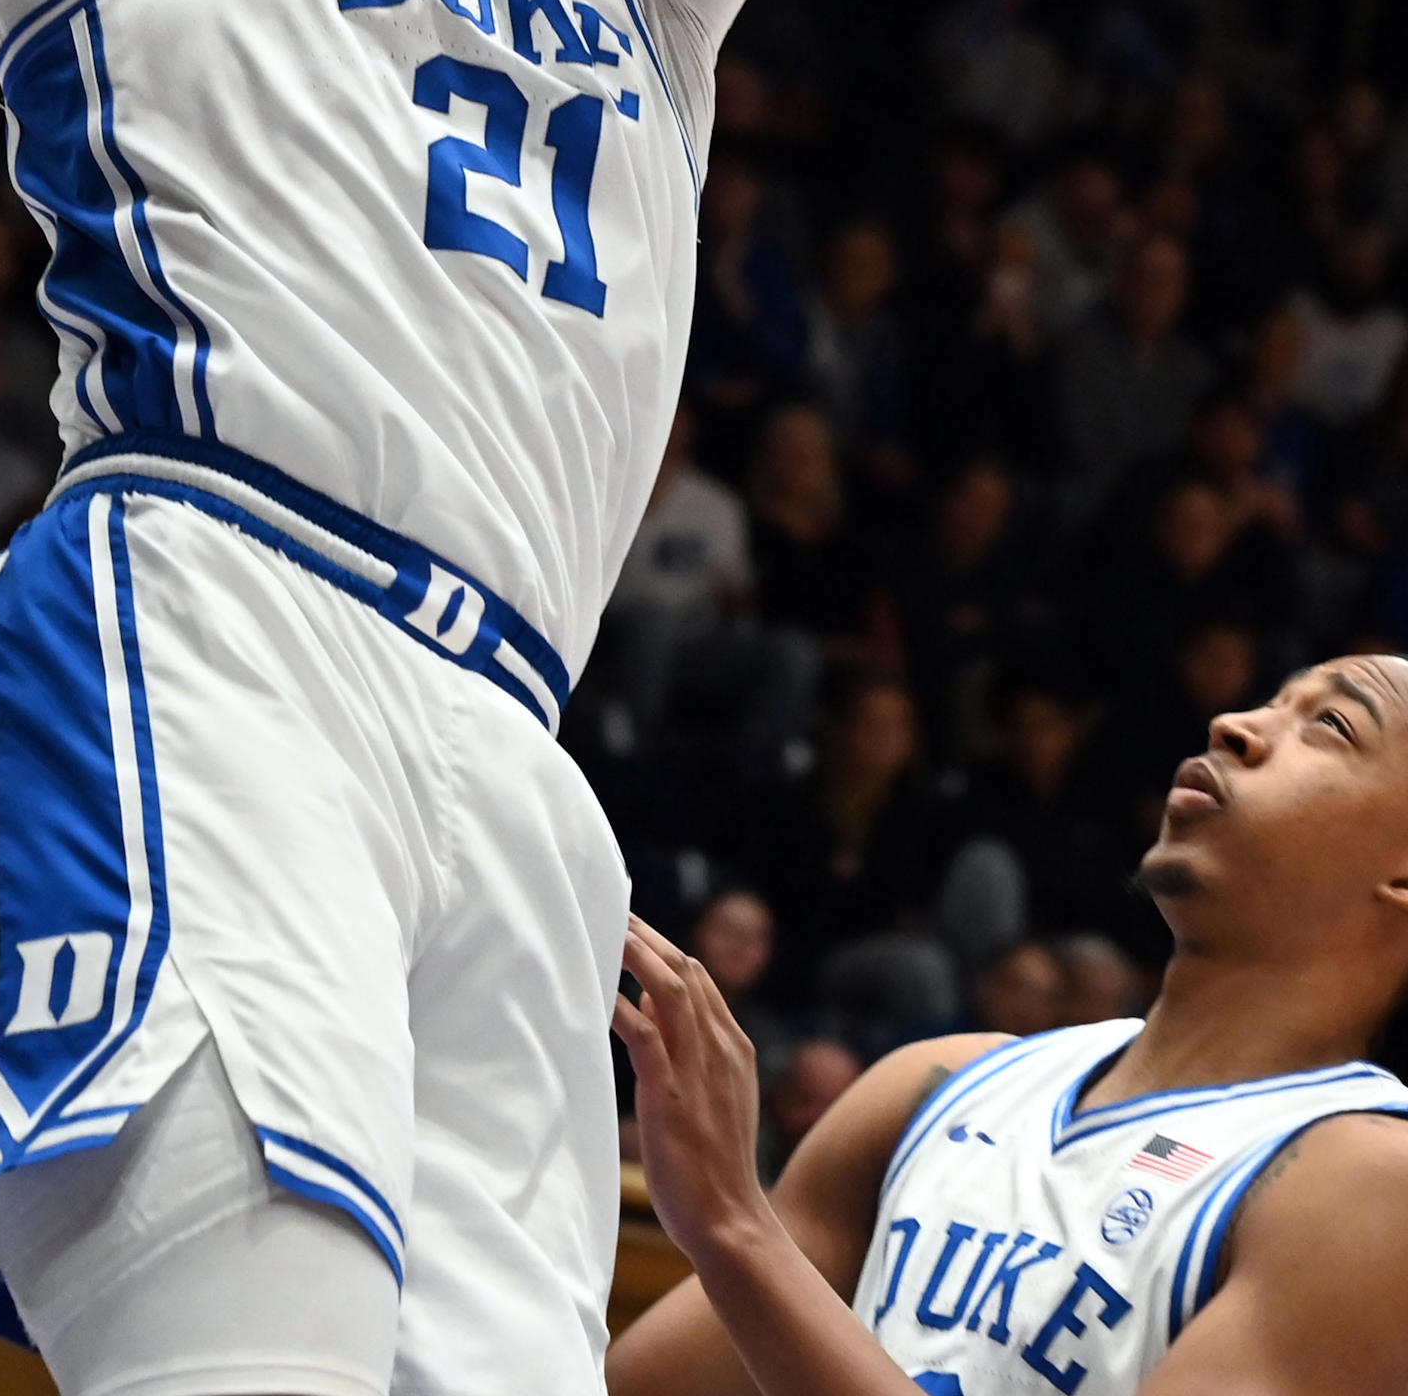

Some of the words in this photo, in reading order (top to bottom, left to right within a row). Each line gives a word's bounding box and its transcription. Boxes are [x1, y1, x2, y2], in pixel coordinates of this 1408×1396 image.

[413, 53, 607, 319] 21
[403, 561, 486, 655] D
[4, 930, 113, 1036] D
